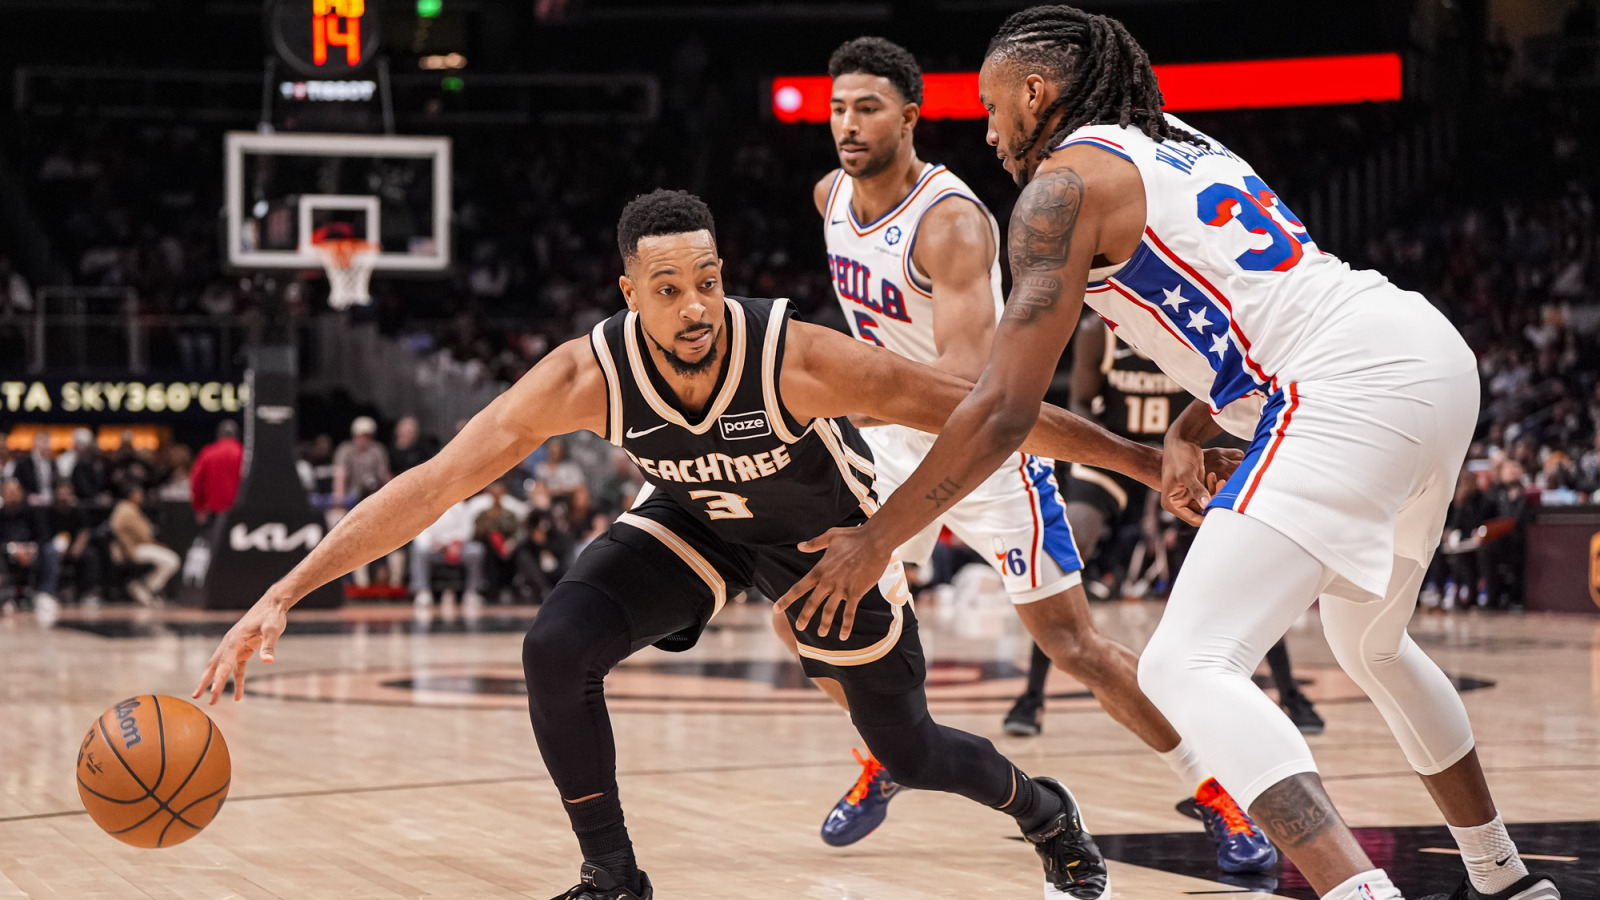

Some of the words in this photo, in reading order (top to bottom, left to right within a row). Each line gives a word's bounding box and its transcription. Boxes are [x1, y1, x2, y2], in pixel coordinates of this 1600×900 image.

[312, 14, 361, 66] 14
[1196, 175, 1313, 272] 33
[827, 252, 913, 324] PHILA
[852, 309, 886, 348] 5
[0, 381, 52, 412] TA
[1125, 395, 1170, 434] 18
[723, 418, 765, 434] paze
[623, 444, 792, 484] EACHTREE
[688, 489, 754, 521] 3
[925, 476, 963, 508] XII
[995, 548, 1027, 576] 76
